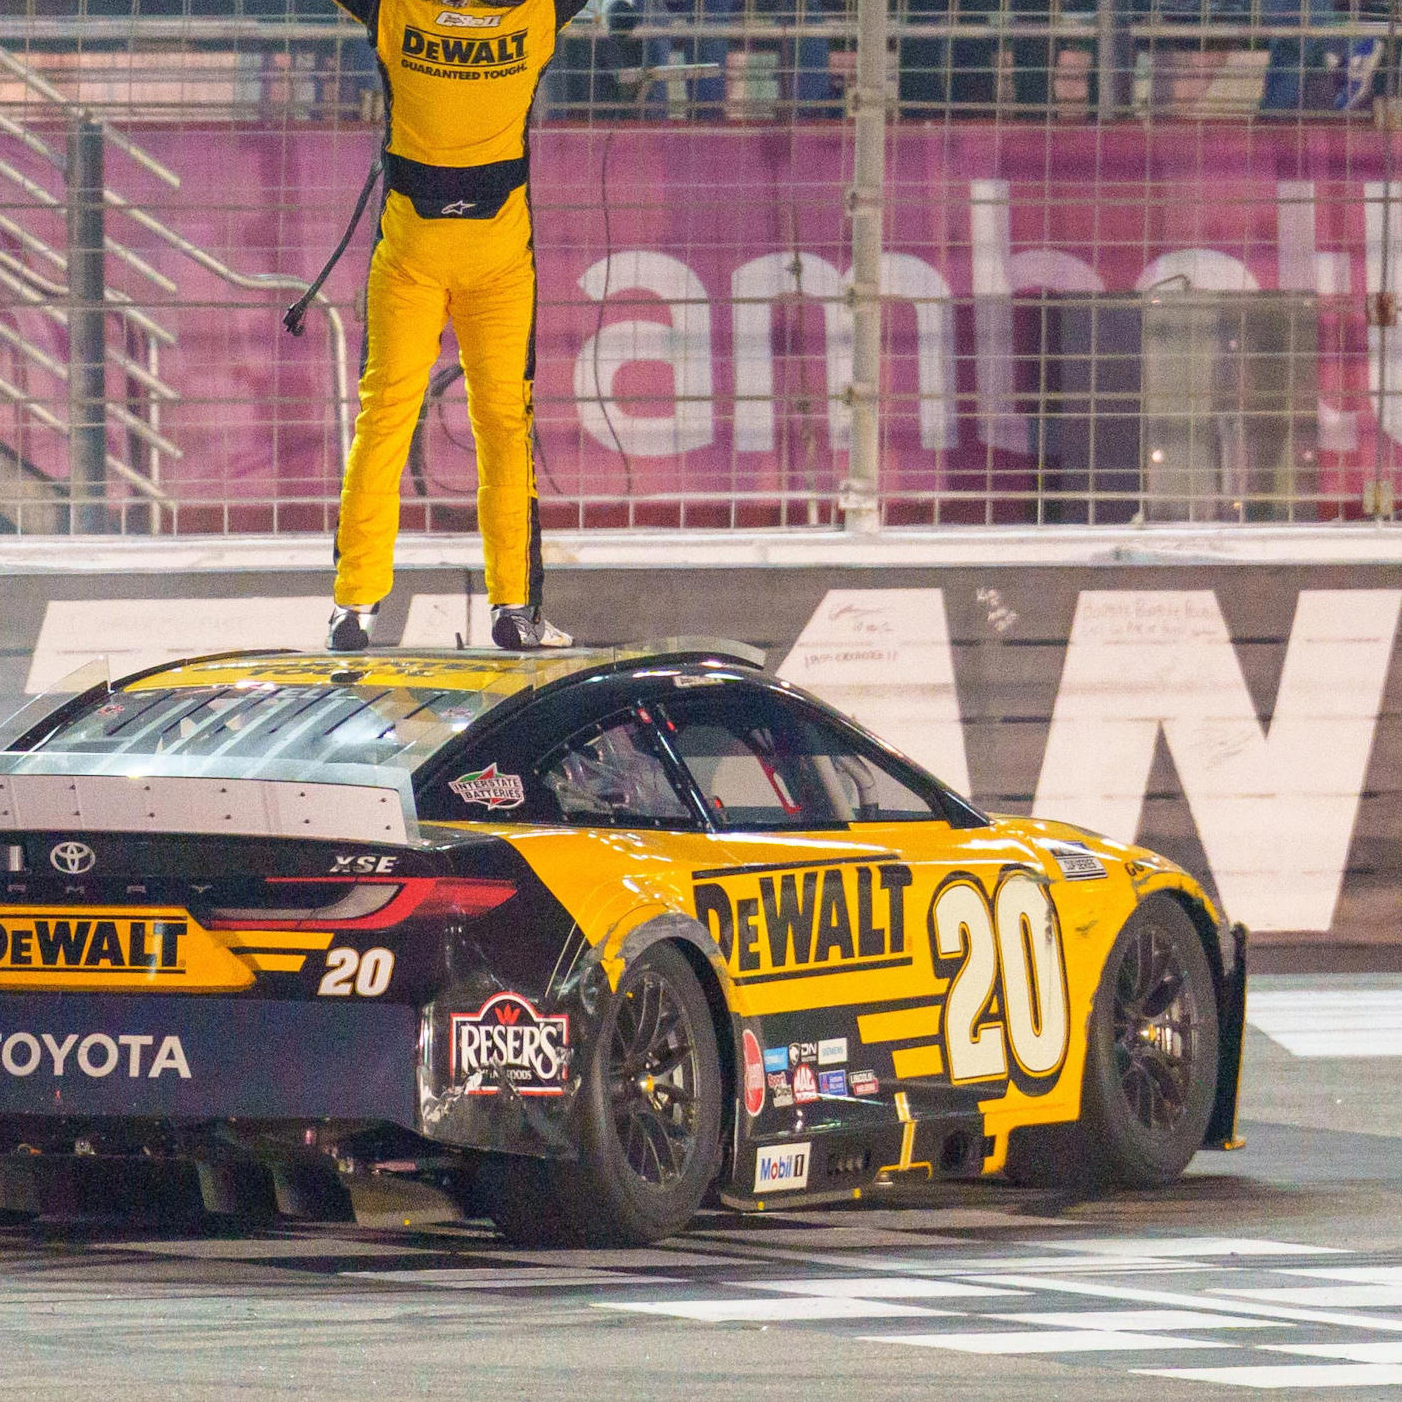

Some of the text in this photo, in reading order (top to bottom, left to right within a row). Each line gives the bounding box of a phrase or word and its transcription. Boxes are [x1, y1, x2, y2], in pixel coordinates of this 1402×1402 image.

[402, 28, 528, 64] DeWALT
[401, 58, 480, 80] GUARANTEED
[453, 777, 520, 792] INTERSTATE
[465, 788, 522, 800] BATTERIES
[330, 855, 397, 873] XSE
[694, 864, 913, 971] DeWALT
[317, 946, 396, 997] 20
[932, 868, 1070, 1087] 20
[460, 1022, 558, 1079] RESER'S
[760, 1154, 793, 1181] Mobil
